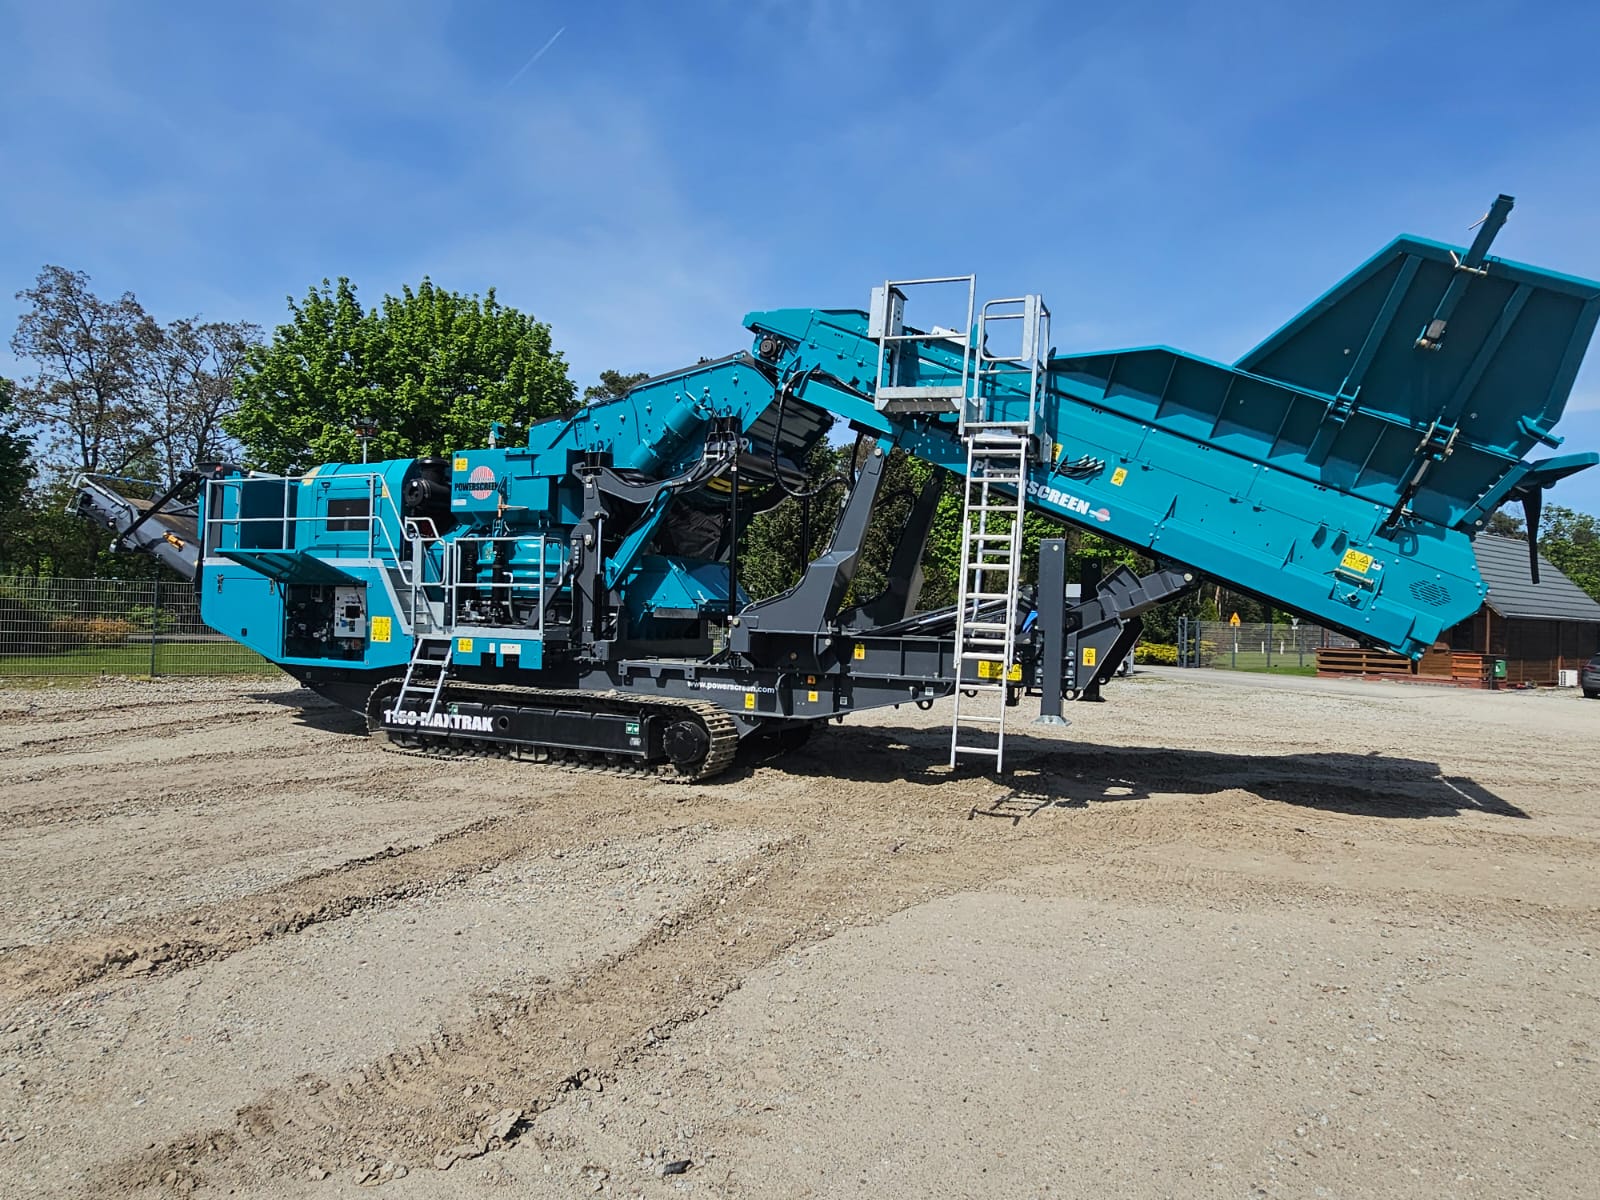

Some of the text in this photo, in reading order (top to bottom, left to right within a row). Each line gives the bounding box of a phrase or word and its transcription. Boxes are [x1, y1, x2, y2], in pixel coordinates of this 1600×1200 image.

[972, 460, 1091, 515] PSCREEN
[687, 681, 775, 694] www.powerscreen.com
[420, 712, 494, 732] MAXTRAK
